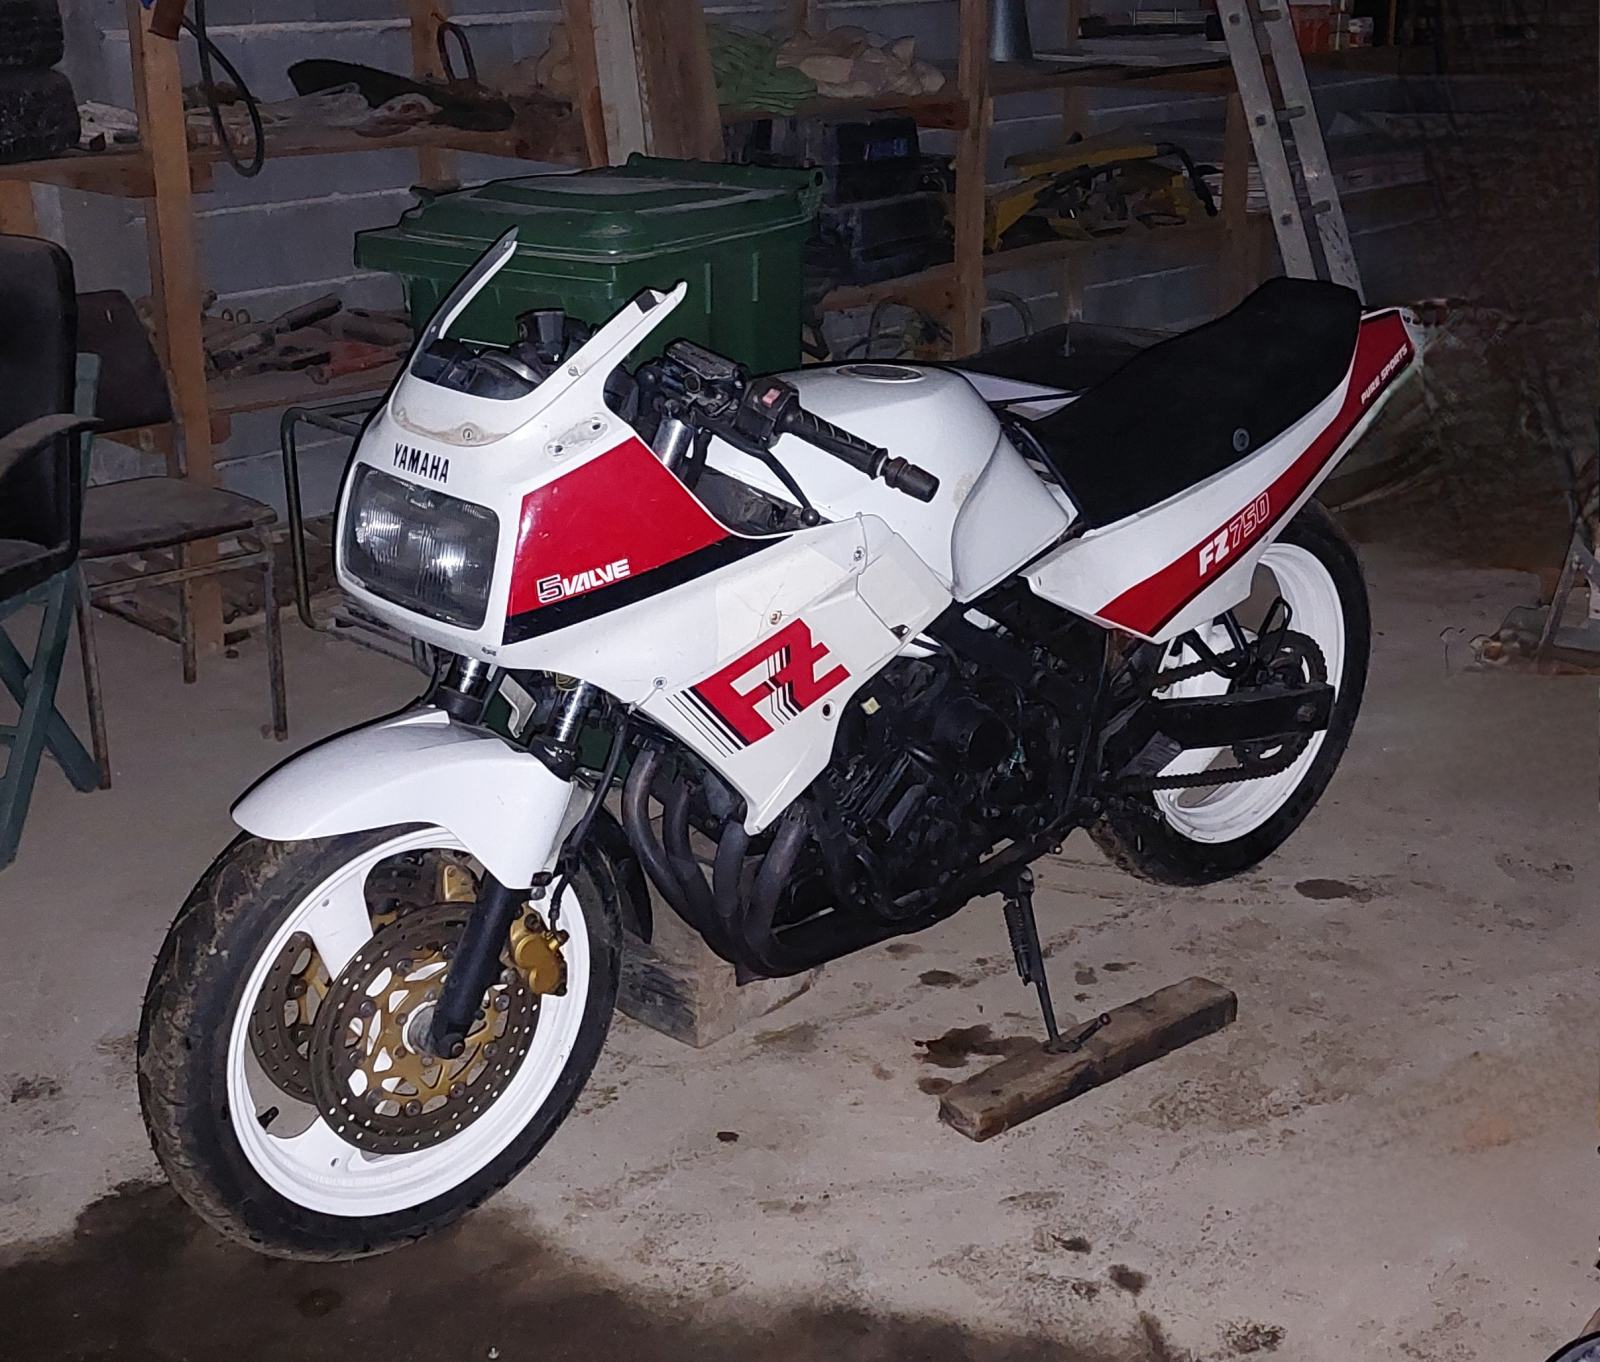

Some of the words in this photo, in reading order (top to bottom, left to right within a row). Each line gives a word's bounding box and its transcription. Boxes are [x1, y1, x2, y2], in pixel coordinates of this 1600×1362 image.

[1380, 342, 1408, 381] SPORTS
[393, 443, 450, 484] YAMAHA
[1199, 492, 1270, 577] FZ750
[688, 618, 851, 746] FZ
